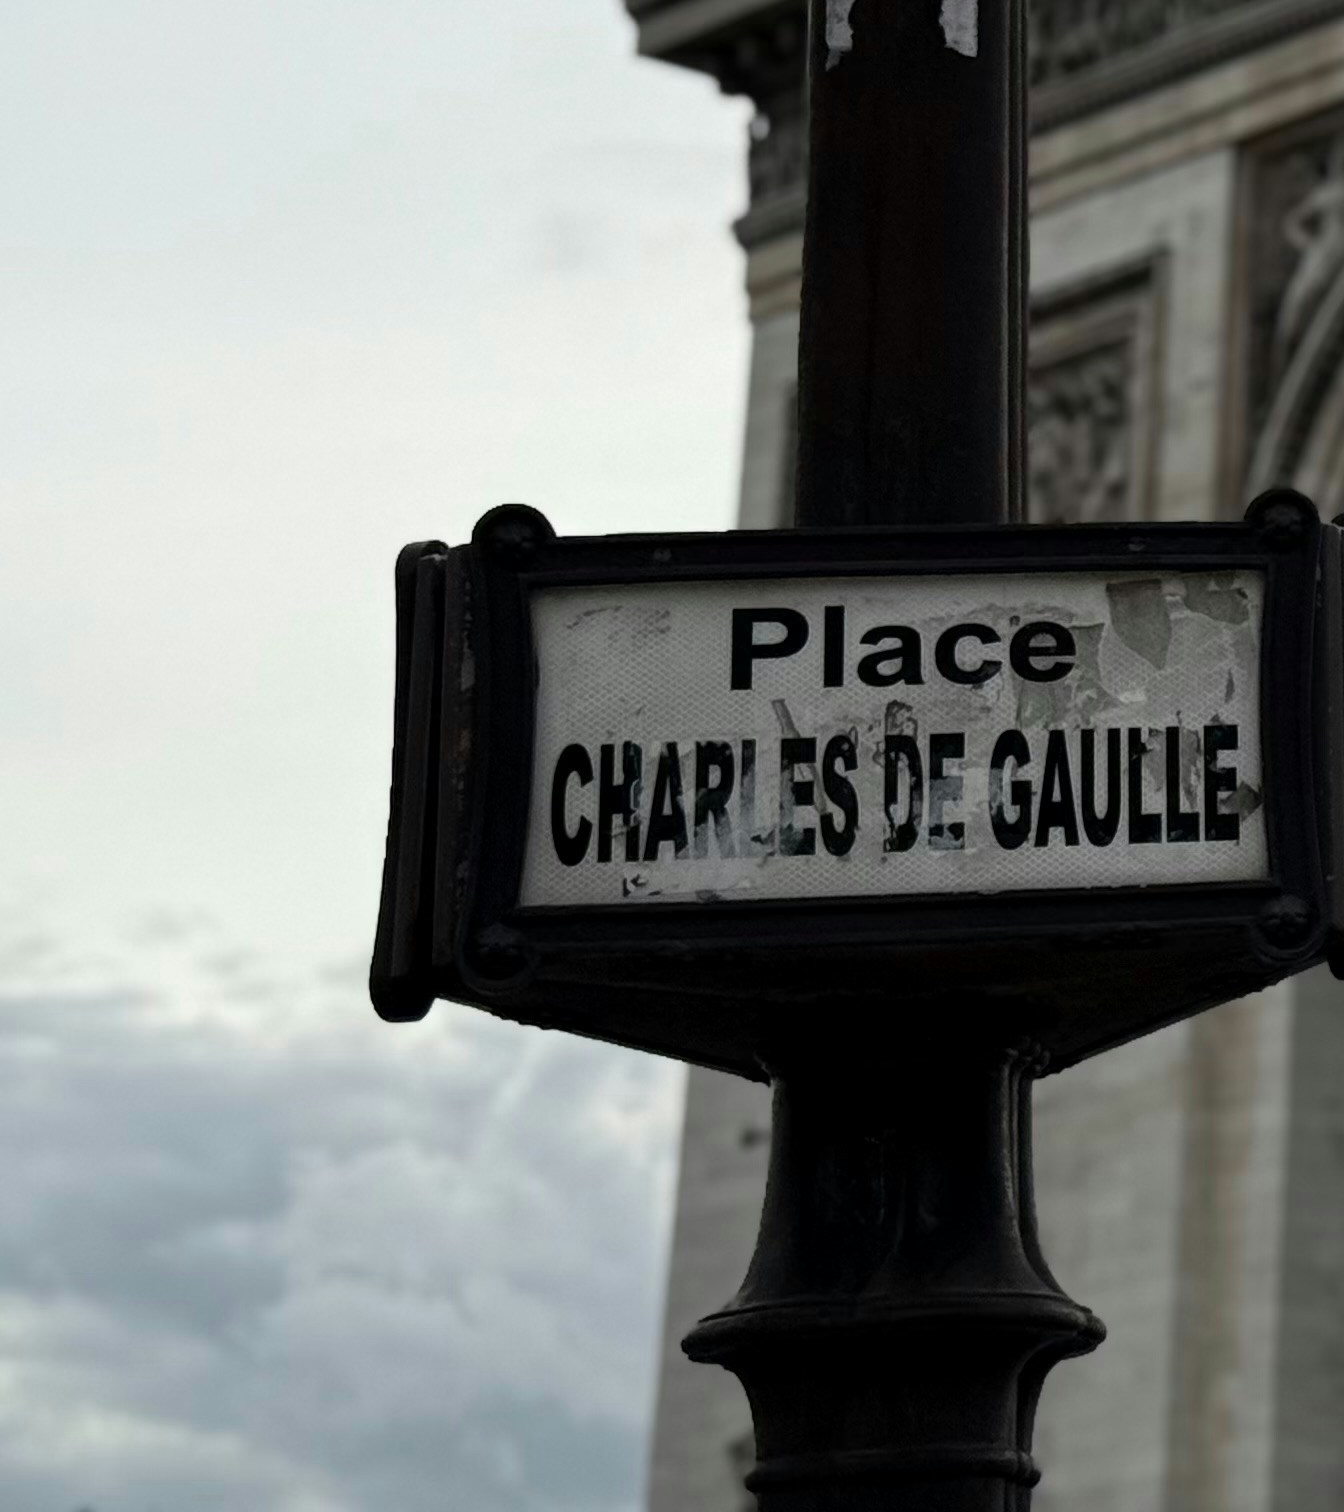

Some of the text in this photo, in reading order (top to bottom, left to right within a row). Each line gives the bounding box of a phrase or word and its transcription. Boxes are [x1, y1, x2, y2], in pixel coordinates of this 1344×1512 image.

[730, 605, 1076, 690] Place
[551, 724, 1240, 866] CHARLES DE GAULLE
